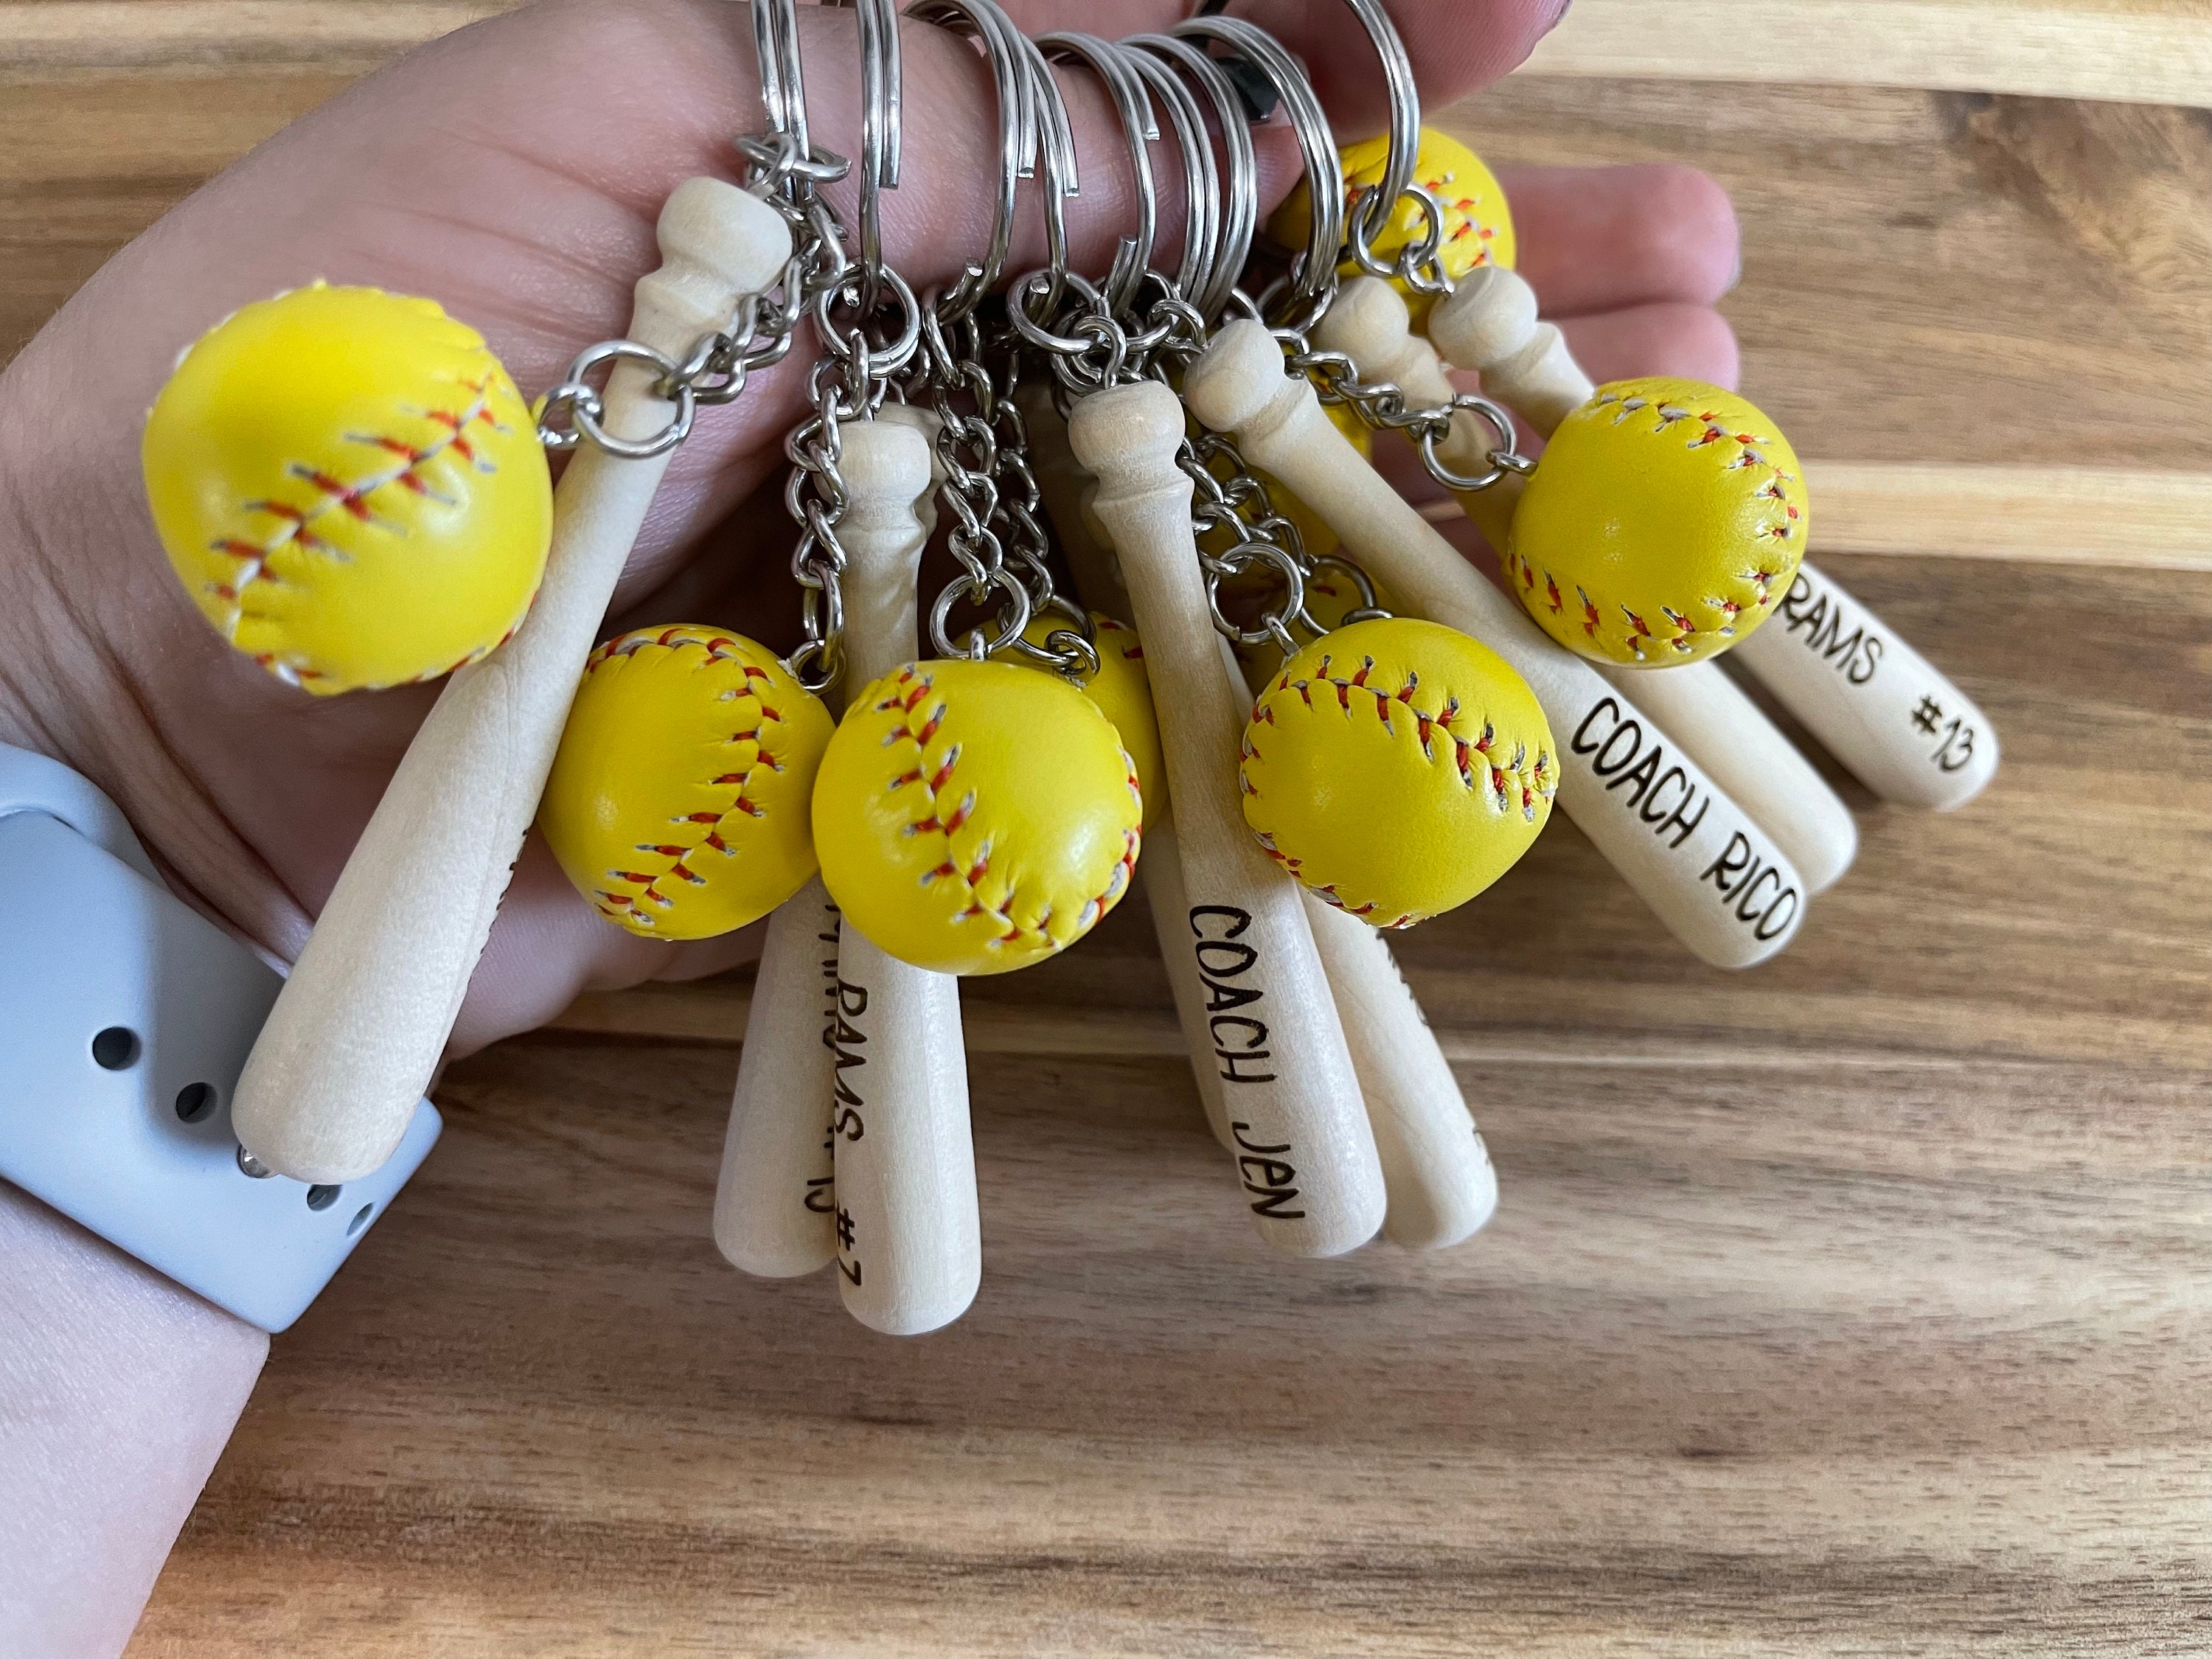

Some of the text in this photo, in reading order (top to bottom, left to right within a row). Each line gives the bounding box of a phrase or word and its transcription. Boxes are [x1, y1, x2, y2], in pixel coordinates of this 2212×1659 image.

[1912, 694, 1976, 772] #13
[1571, 697, 1798, 941] COACH RICO
[1189, 905, 1278, 1083] COACH
[835, 1200, 863, 1287] #7
